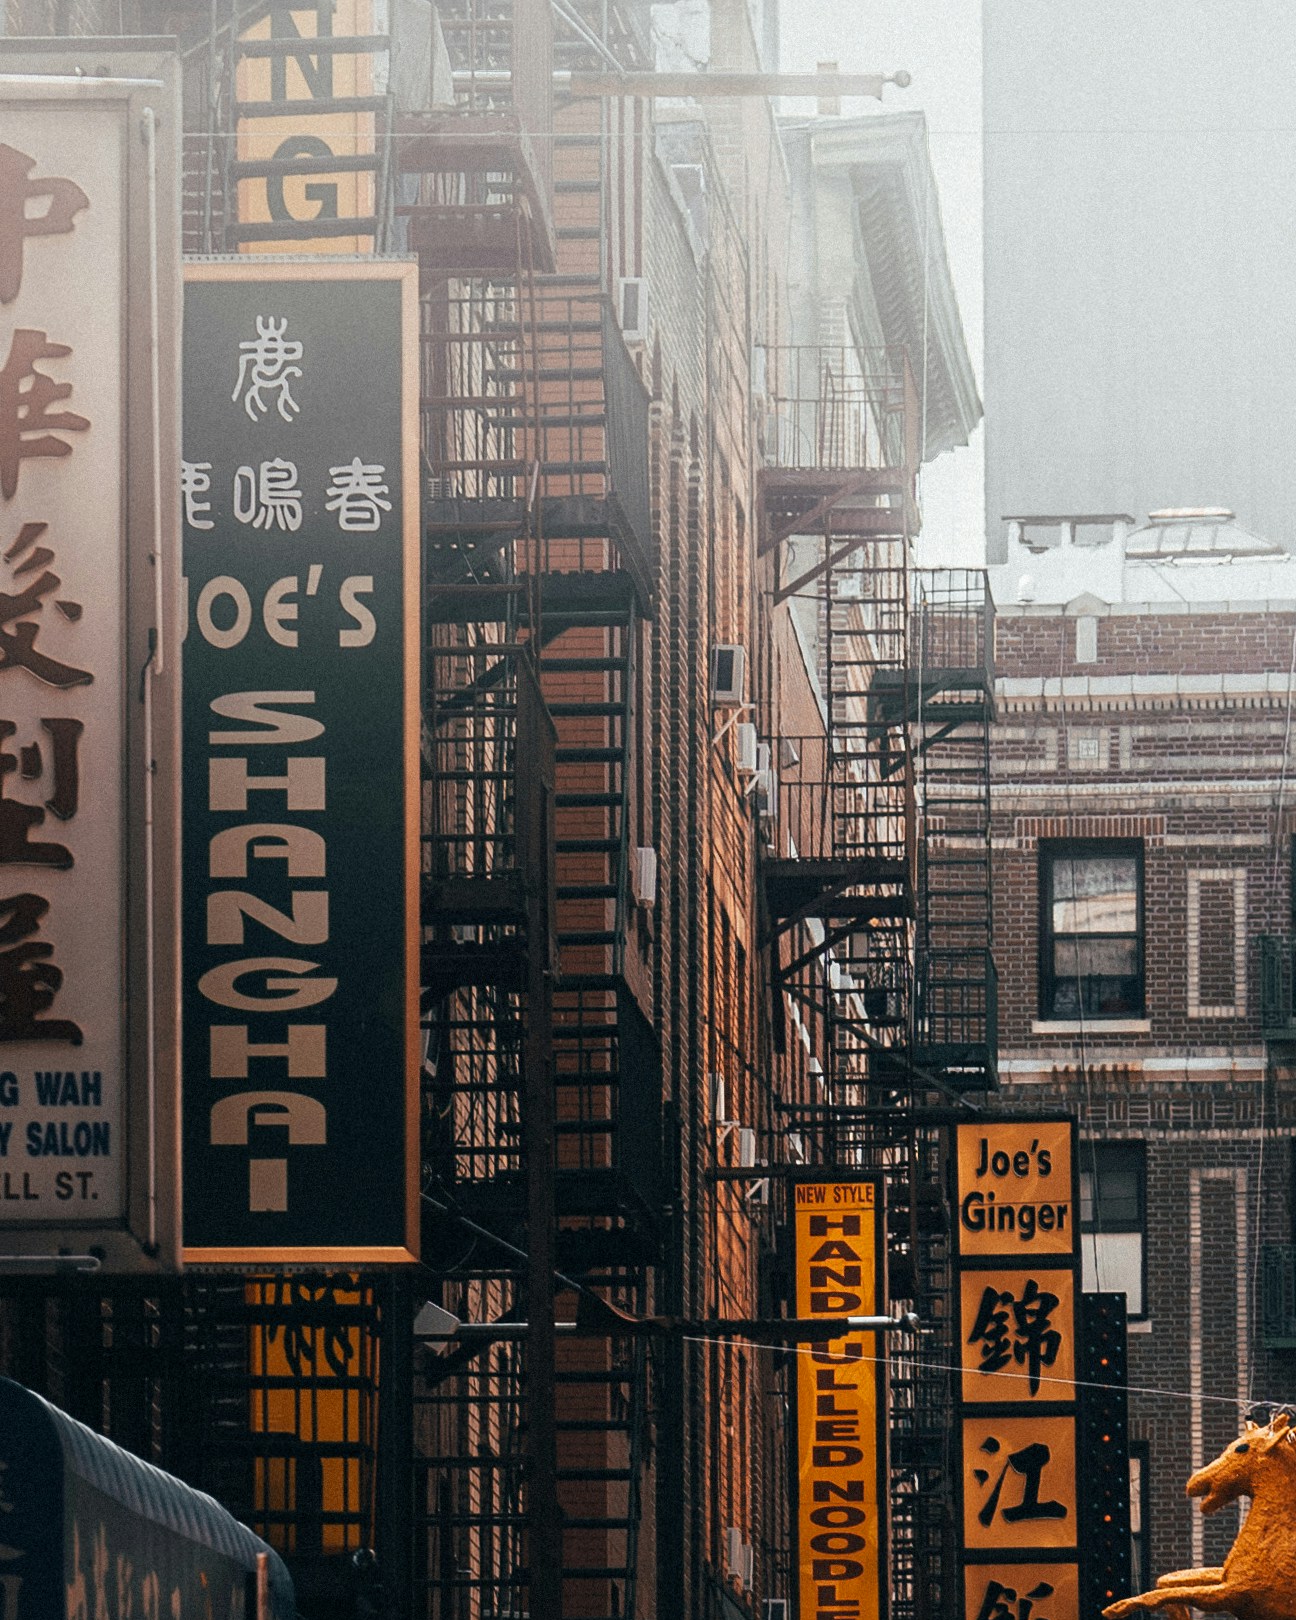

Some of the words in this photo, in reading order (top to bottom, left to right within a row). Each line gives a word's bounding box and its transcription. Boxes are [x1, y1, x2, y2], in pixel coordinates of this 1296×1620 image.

[182, 564, 379, 649] OE'S
[197, 690, 339, 1212] SHANGHAI
[35, 1071, 102, 1107] WAH
[26, 1121, 110, 1157] SALON
[976, 1139, 1052, 1178] Joe's
[55, 1171, 99, 1201] ST.
[796, 1186, 826, 1204] NEW
[833, 1184, 874, 1203] STYLE
[961, 1192, 1069, 1240] Ginger
